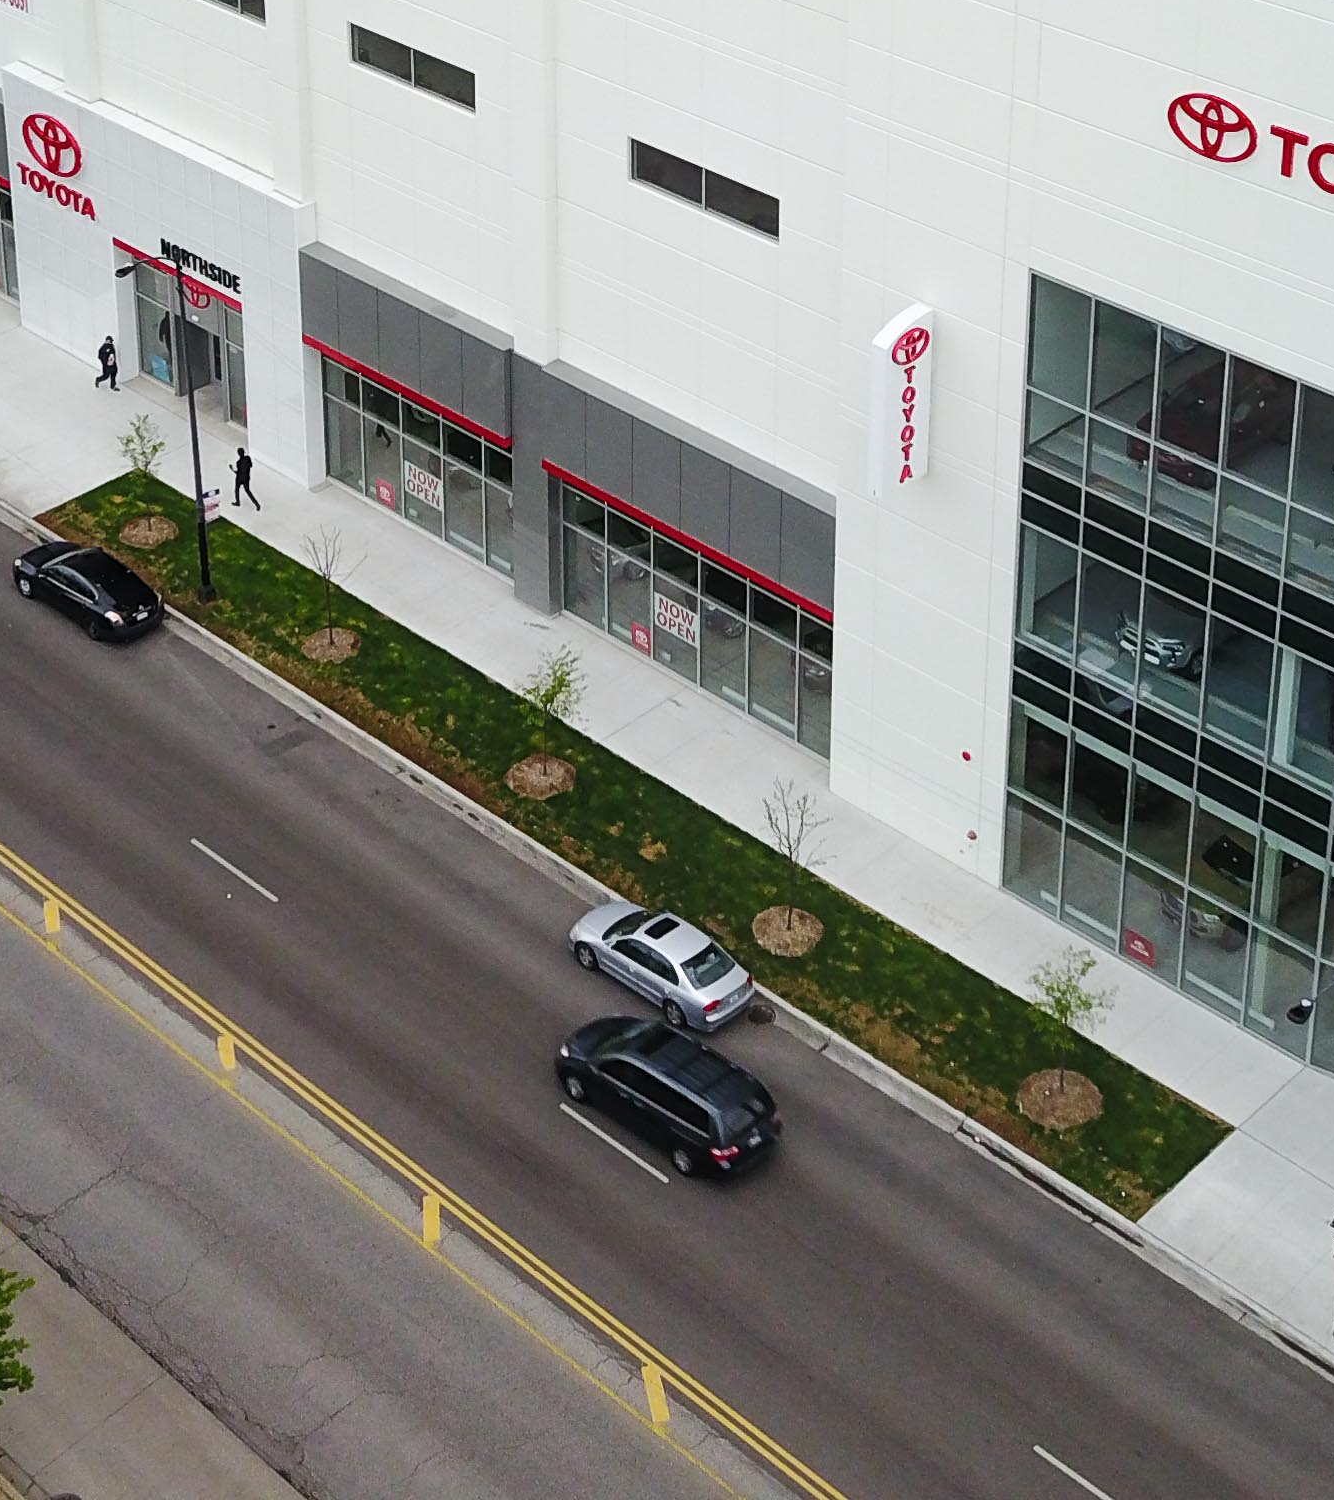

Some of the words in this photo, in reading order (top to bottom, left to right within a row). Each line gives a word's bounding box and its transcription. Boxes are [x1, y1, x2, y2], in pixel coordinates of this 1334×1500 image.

[17, 162, 97, 221] TOYOTA
[160, 238, 241, 294] NORTHSIDE
[899, 365, 916, 484] TOYOTA
[407, 478, 440, 508] OPEN
[408, 464, 439, 492] NOW
[657, 612, 695, 644] OPEN
[659, 597, 694, 627] NOW
